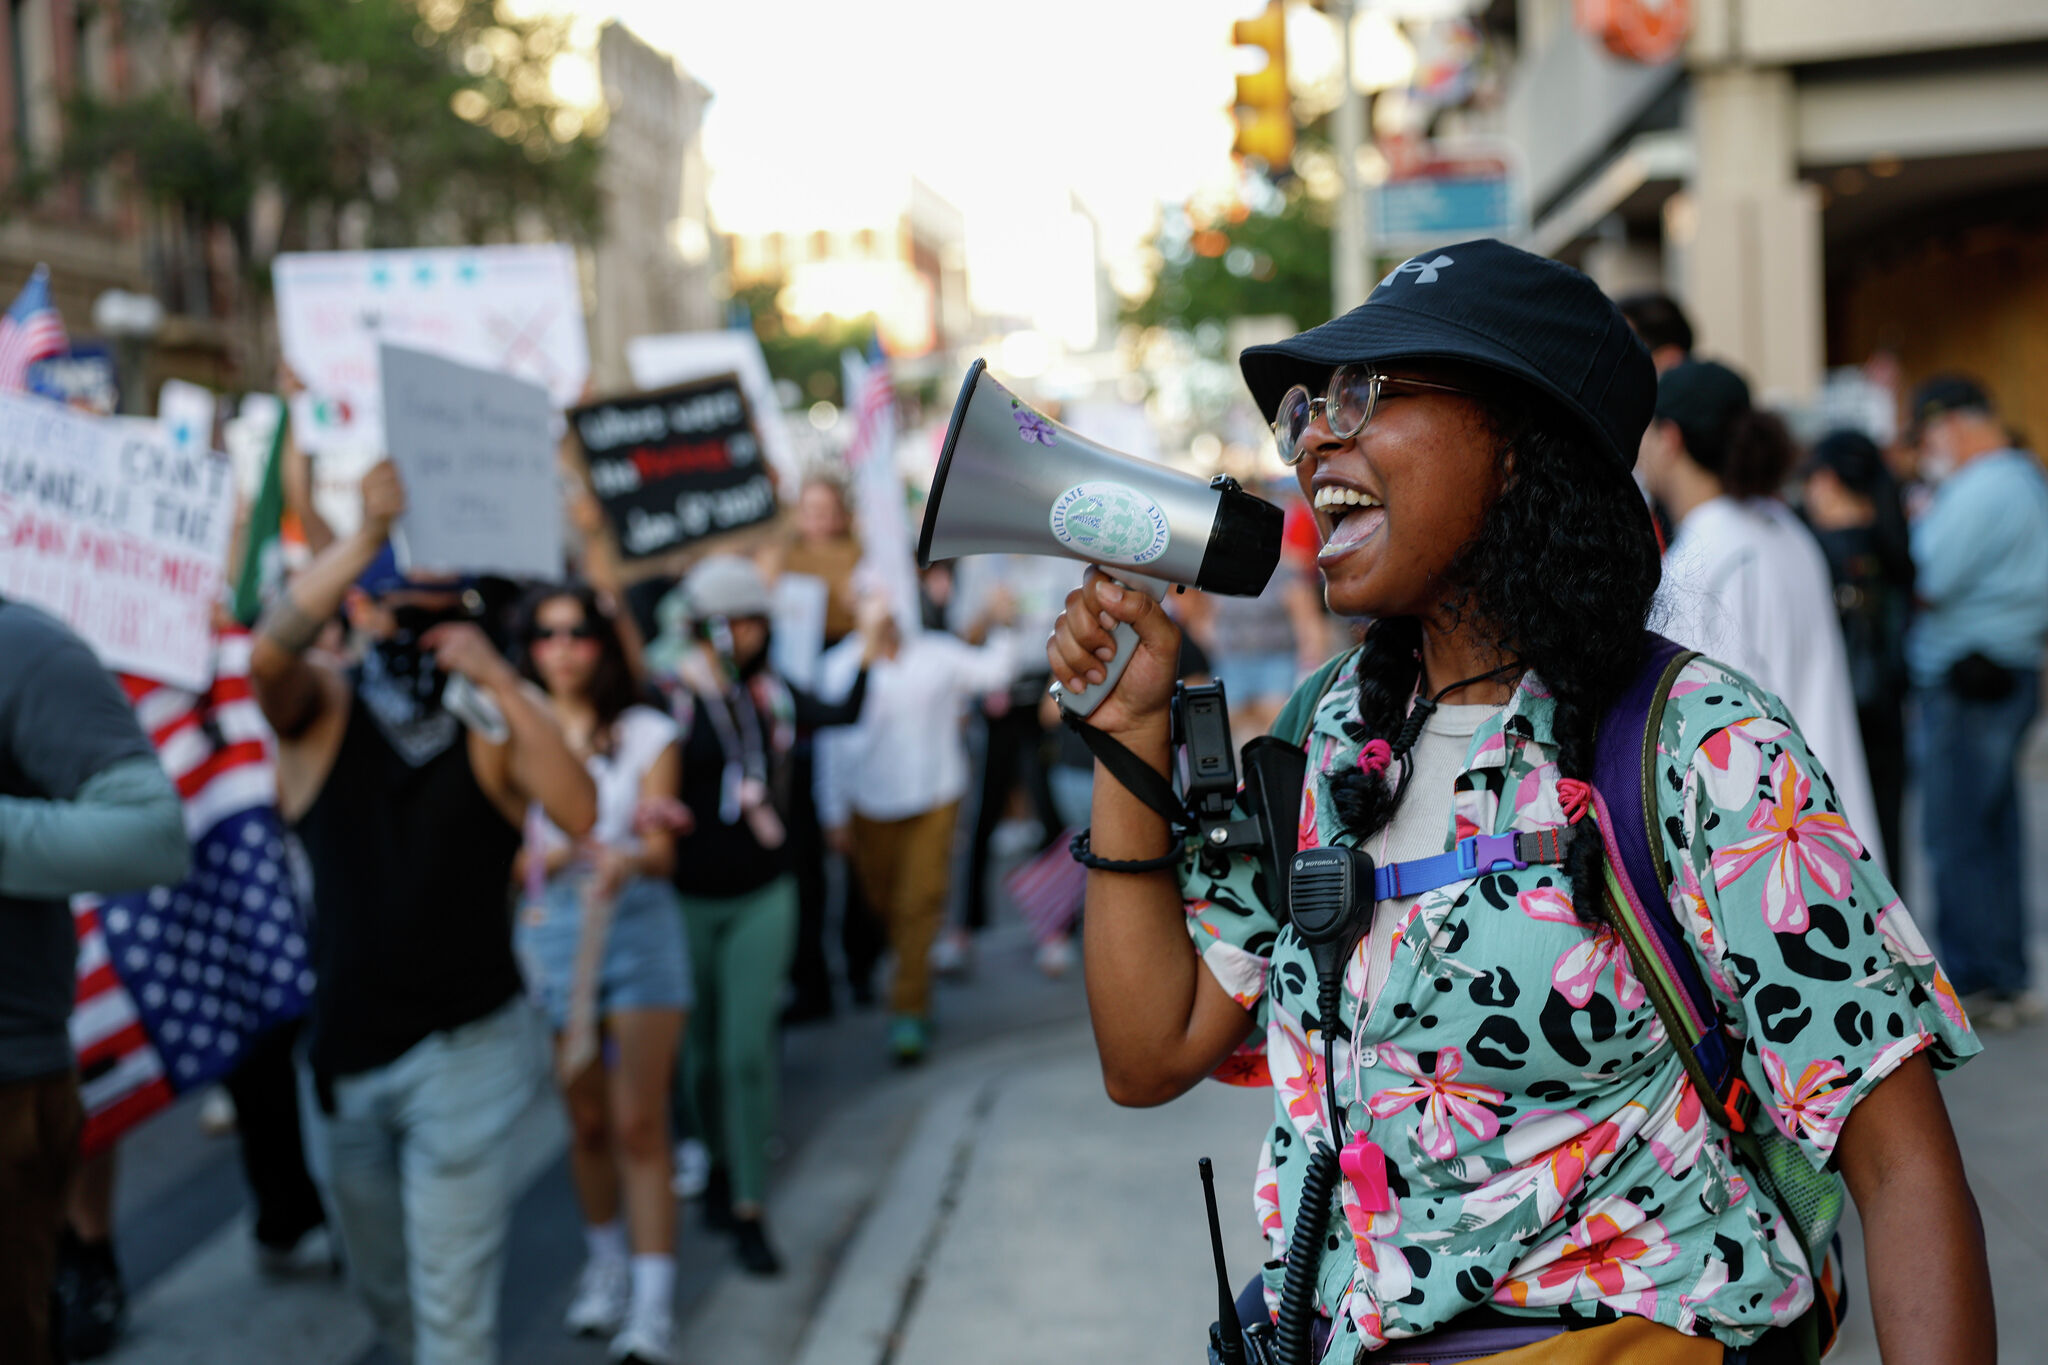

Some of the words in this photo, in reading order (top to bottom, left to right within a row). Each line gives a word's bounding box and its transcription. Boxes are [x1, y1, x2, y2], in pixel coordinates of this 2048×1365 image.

[1053, 486, 1085, 543] CULTIVATE
[1133, 505, 1166, 562] RESISTANCE
[1304, 859, 1338, 867] MOTOROLA
